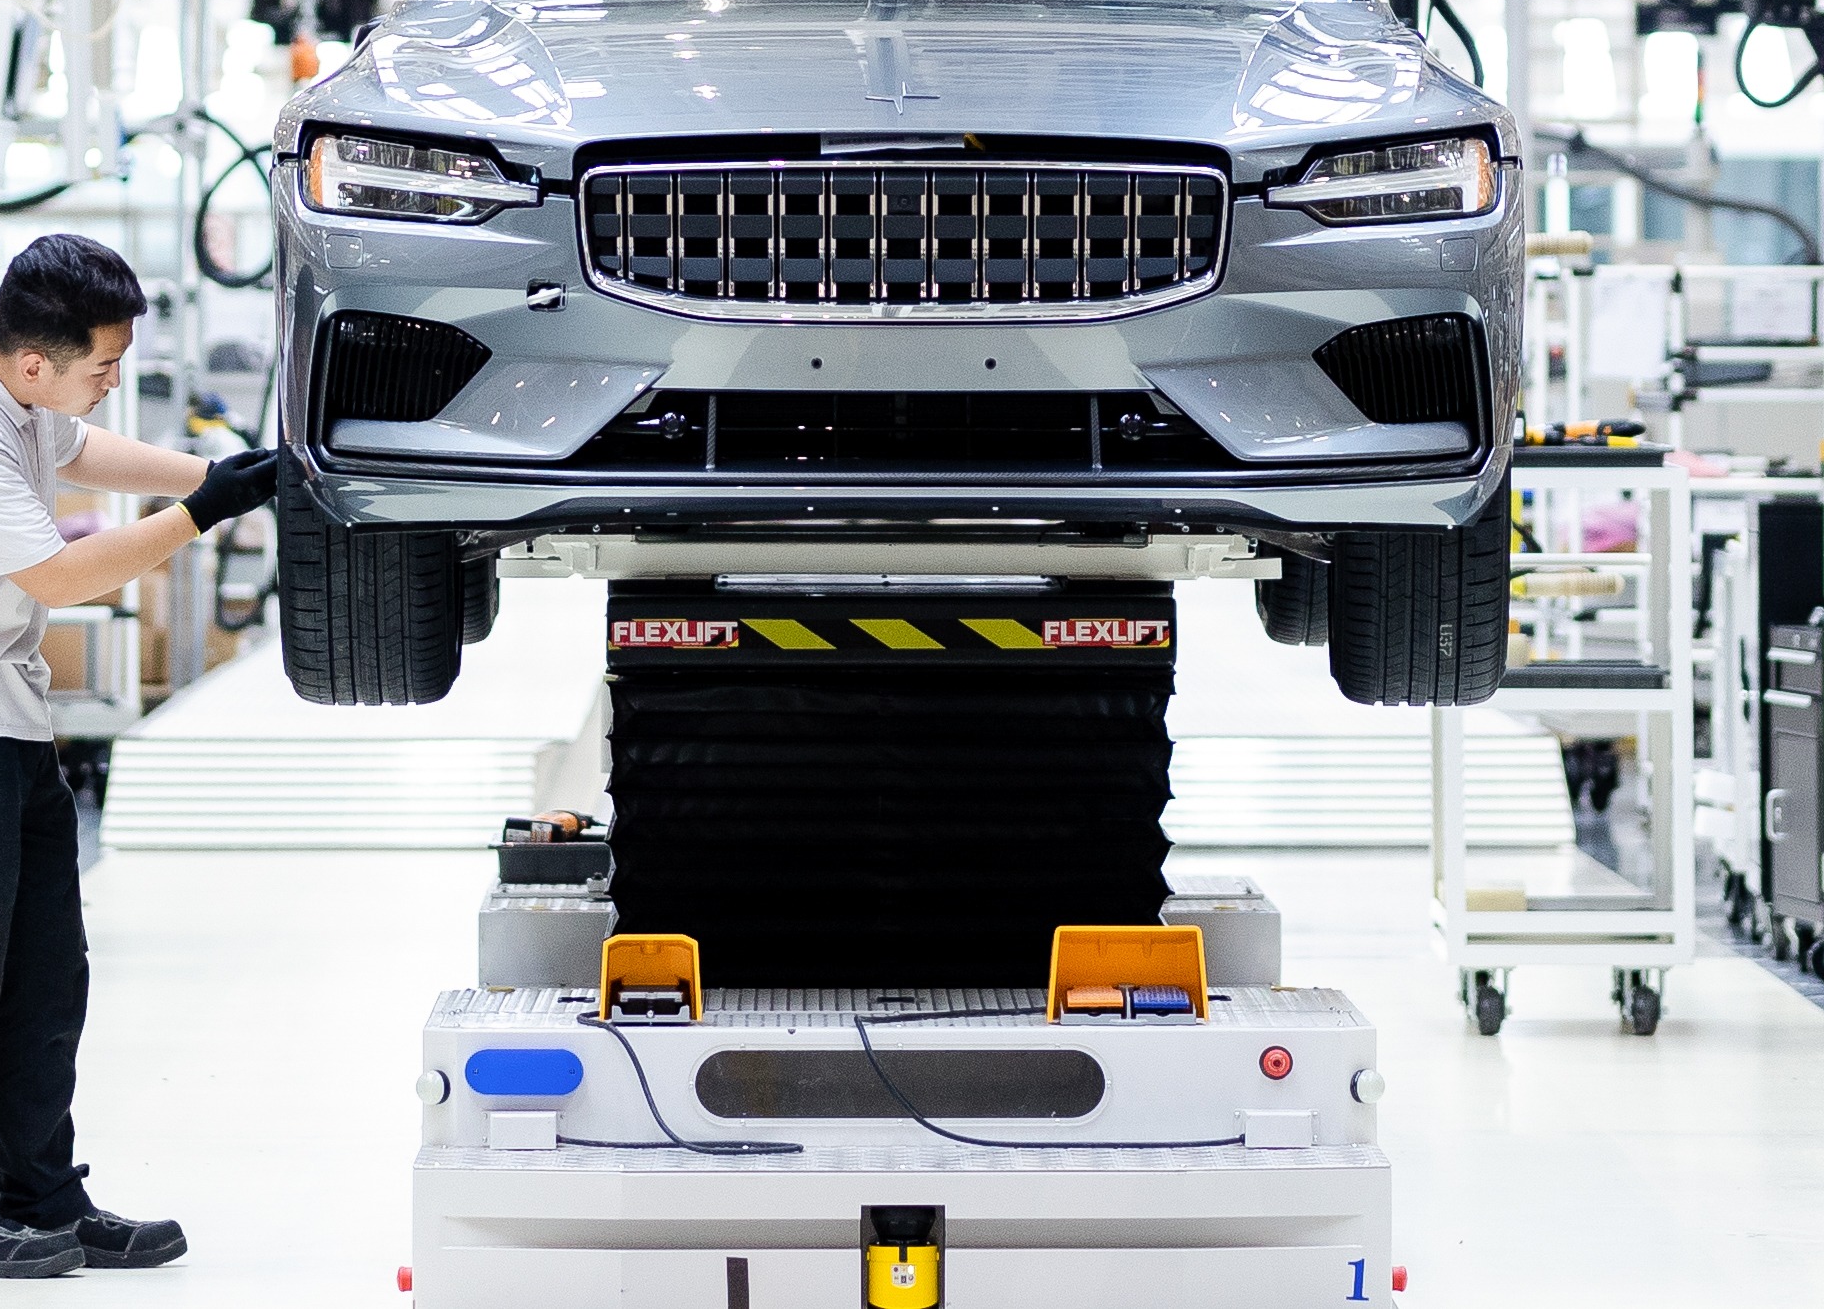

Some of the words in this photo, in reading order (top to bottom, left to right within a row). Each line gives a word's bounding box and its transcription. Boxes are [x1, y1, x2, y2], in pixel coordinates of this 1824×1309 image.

[613, 621, 739, 642] FLEXLIFT
[1044, 620, 1169, 641] FLEXLIFT
[1346, 1258, 1369, 1301] 1
